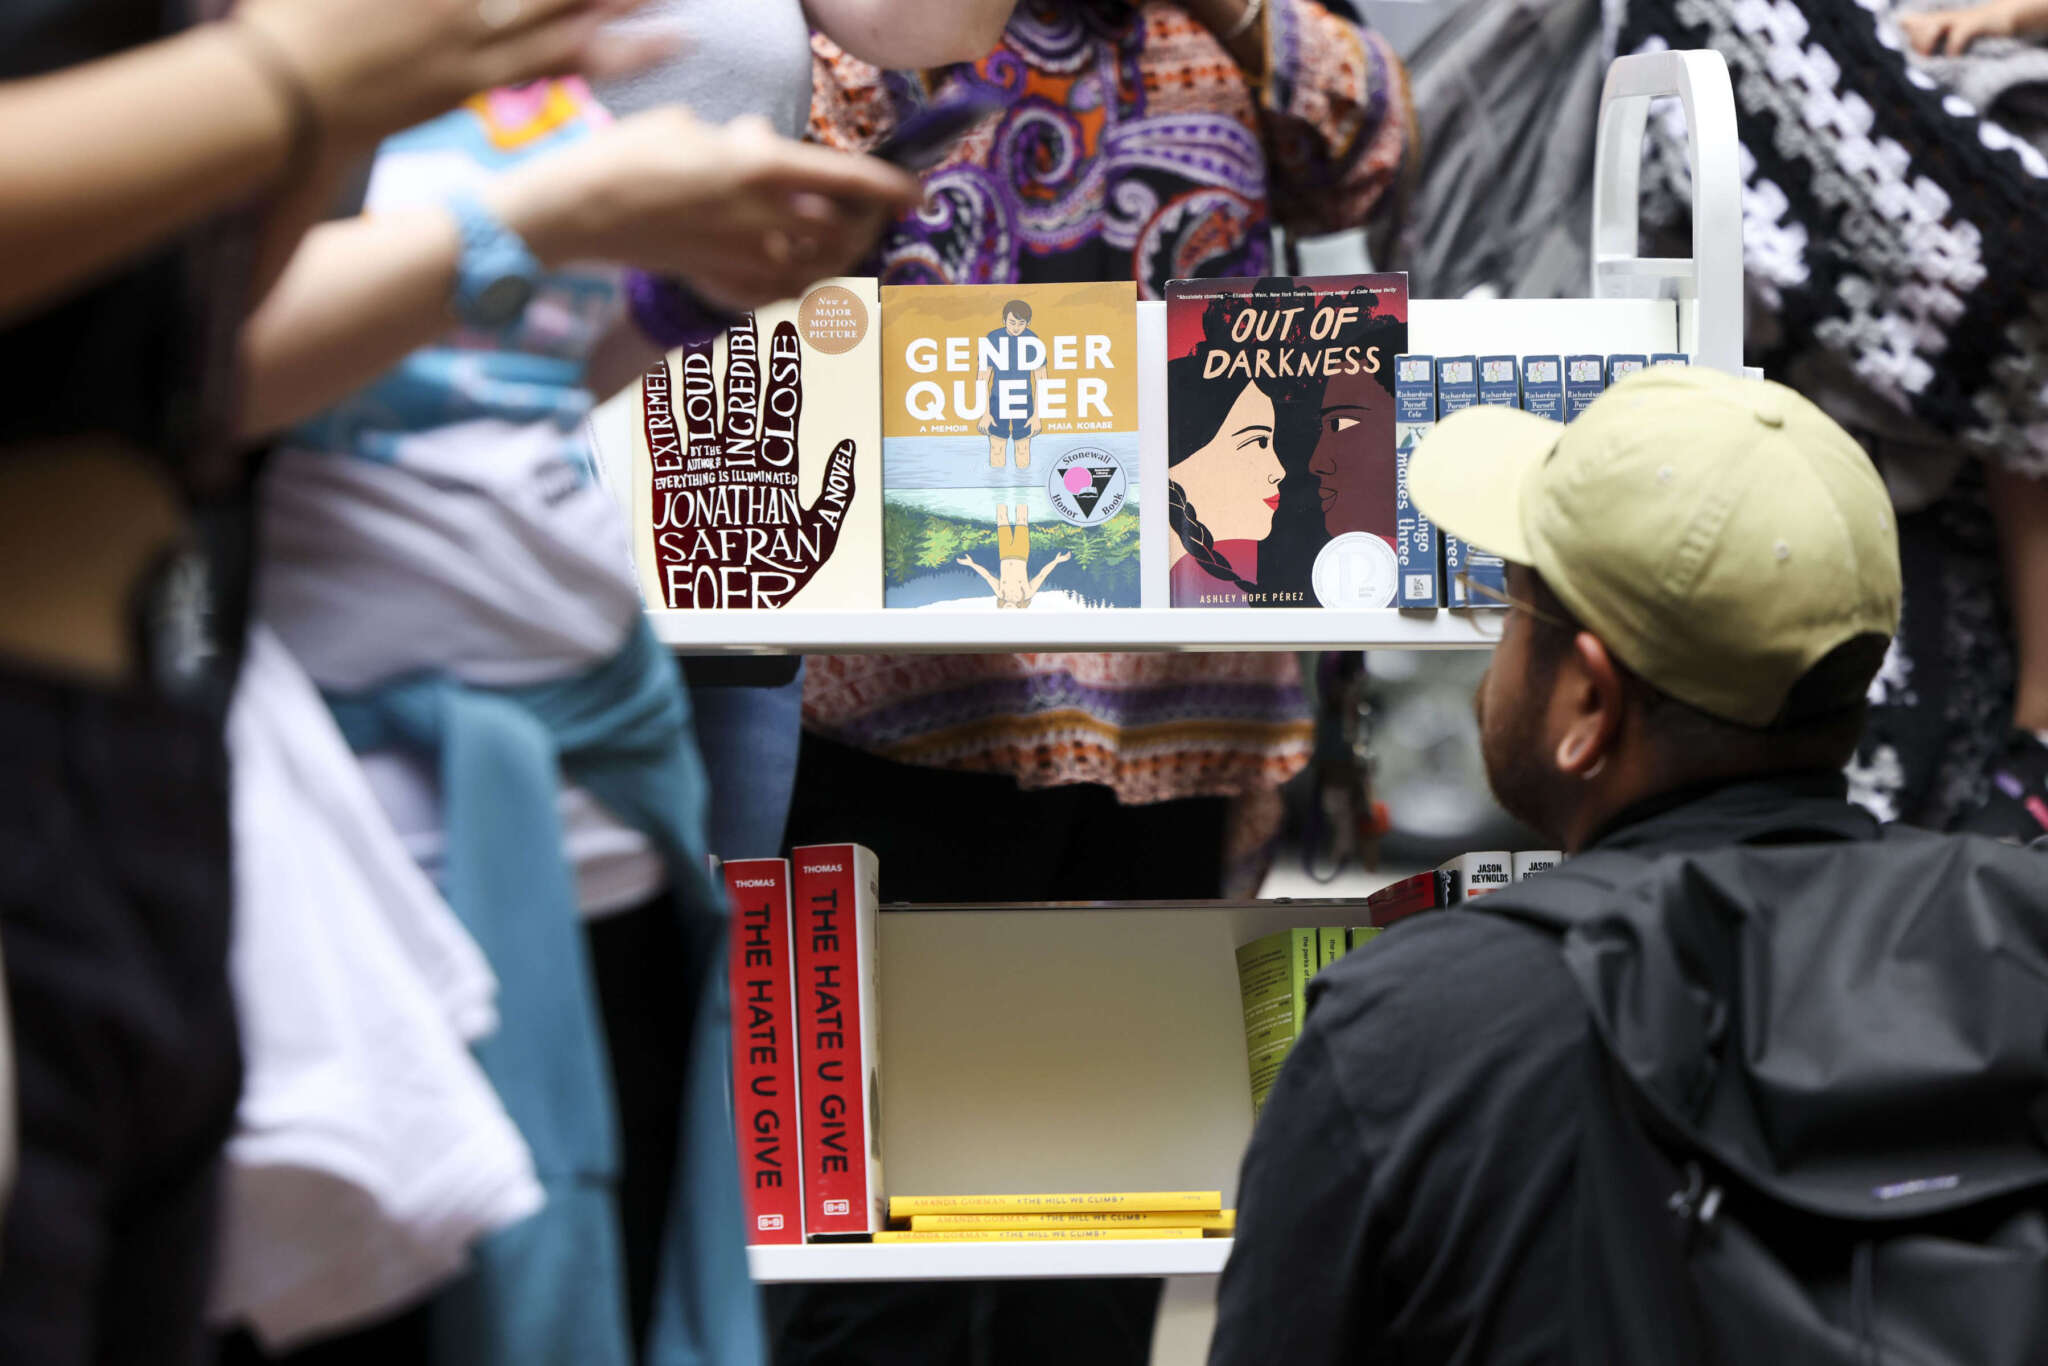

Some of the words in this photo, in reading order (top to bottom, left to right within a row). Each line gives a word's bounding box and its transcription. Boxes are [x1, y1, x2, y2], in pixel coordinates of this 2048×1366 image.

[810, 319, 857, 327] MOTION
[815, 308, 852, 317] MAJOR
[809, 330, 858, 339] PICTURE
[1231, 307, 1305, 343] OUT
[1309, 306, 1359, 341] OF
[905, 334, 1115, 373] GENDER
[1202, 345, 1381, 380] DARKNESS
[684, 353, 717, 442] LOUD
[761, 335, 800, 467] CLOSE
[905, 377, 1114, 421] QUEER
[1396, 390, 1433, 398] Richardson
[1403, 400, 1427, 408] Parnell
[1440, 391, 1477, 399] Richardson
[1481, 390, 1517, 398] Richardson
[1525, 391, 1561, 399] Richardson
[1077, 421, 1113, 429] KOBABE
[690, 445, 702, 456] BY
[703, 445, 722, 455] THE
[1062, 451, 1112, 465] Stonewall
[687, 458, 715, 471] AUTHOR
[824, 441, 854, 509] NOVEL
[654, 471, 716, 490] EVERYTHING
[718, 470, 730, 482] IS
[731, 469, 798, 486] ILLUMINATED
[653, 484, 802, 530] JONATHAN
[1052, 494, 1078, 518] Honor
[1102, 493, 1123, 515] Book
[817, 509, 841, 531] A
[1398, 517, 1415, 566] three
[1413, 512, 1429, 552] ango
[658, 523, 823, 573] SAFRAN
[666, 563, 796, 609] FOER
[1199, 593, 1236, 604] ASHLEY
[1241, 592, 1268, 602] HOPE
[1272, 590, 1304, 602] PÉREZ
[803, 864, 843, 874] THOMAS
[1471, 873, 1508, 883] REYNOLDS
[1477, 863, 1502, 873] JASON
[735, 879, 775, 888] THOMAS
[811, 888, 839, 953] THE
[744, 903, 772, 968] THE
[814, 965, 843, 1050] HATE
[747, 980, 777, 1065] HATE
[817, 1061, 843, 1082] U
[751, 1076, 778, 1097] U
[820, 1094, 849, 1175] GIVE
[753, 1109, 782, 1189] GIVE
[914, 1199, 957, 1207] AMANDA
[1088, 1195, 1119, 1203] CLIMB
[1092, 1213, 1107, 1221] WE
[1111, 1213, 1141, 1221] CLIMB
[1070, 1230, 1100, 1238] CLIMB
